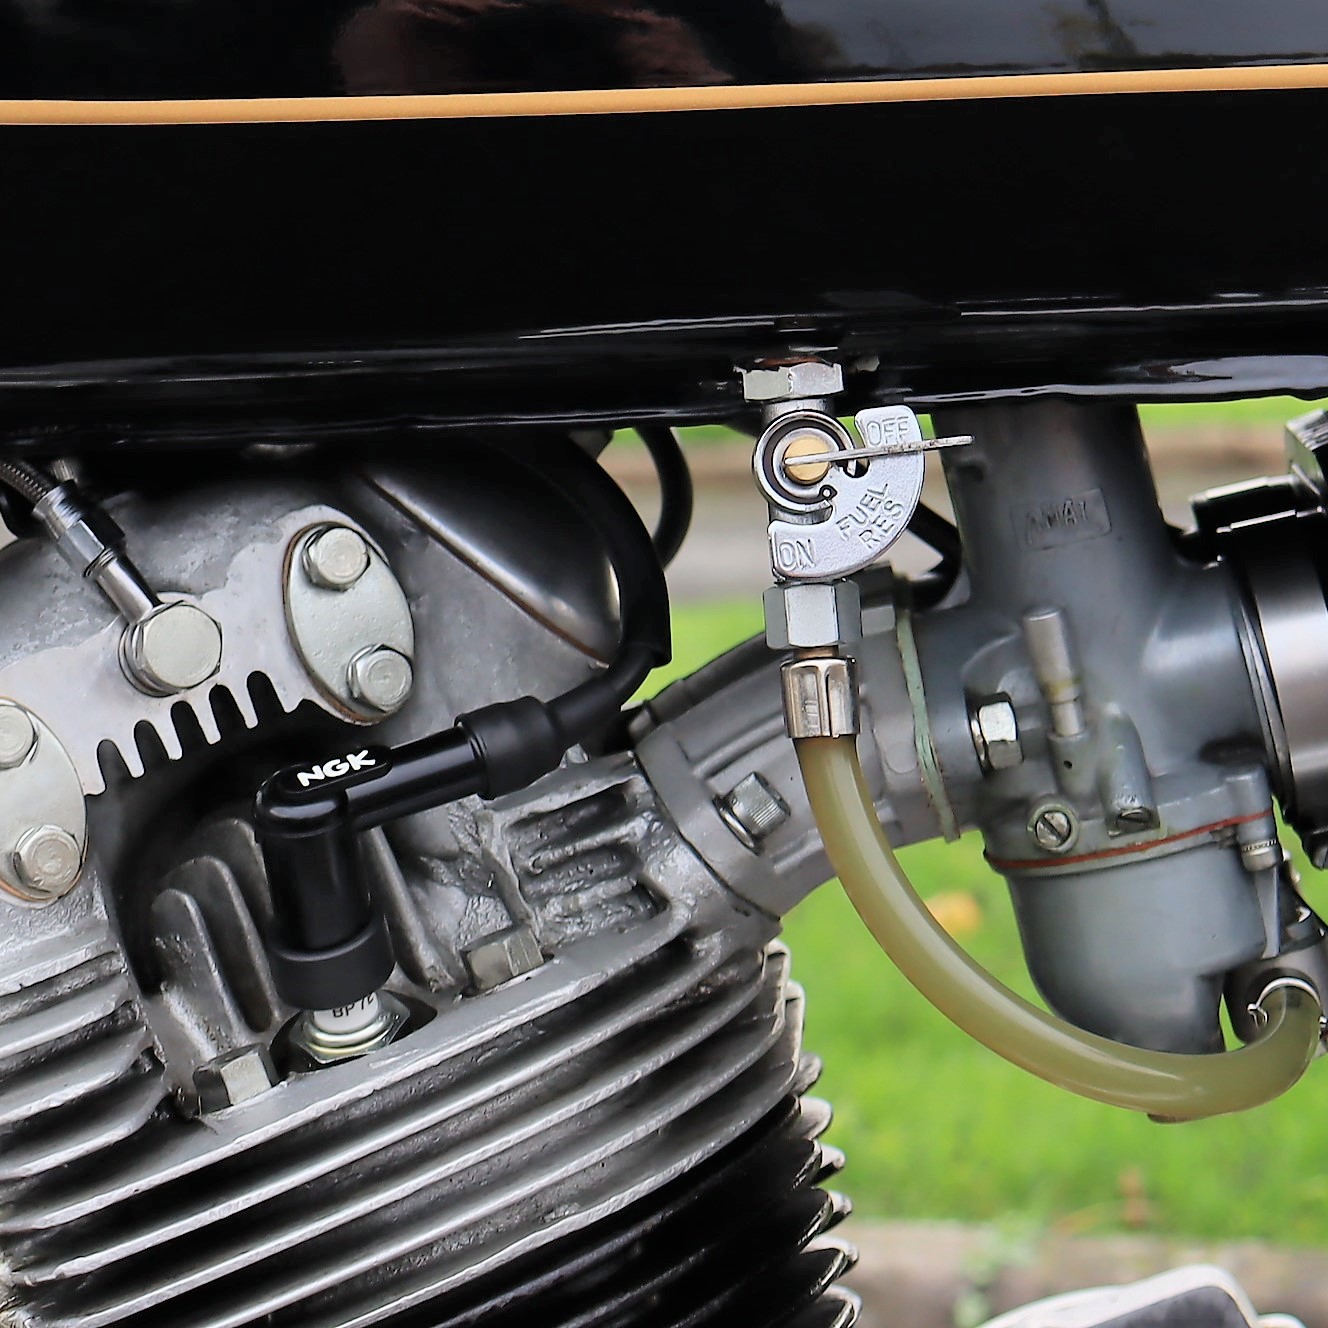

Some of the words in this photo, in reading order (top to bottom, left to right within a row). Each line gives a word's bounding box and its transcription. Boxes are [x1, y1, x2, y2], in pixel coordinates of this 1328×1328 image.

[866, 416, 909, 446] OFF
[836, 483, 888, 540] FUEL
[859, 500, 904, 549] RES
[777, 539, 816, 571] ON
[297, 750, 376, 787] NGK
